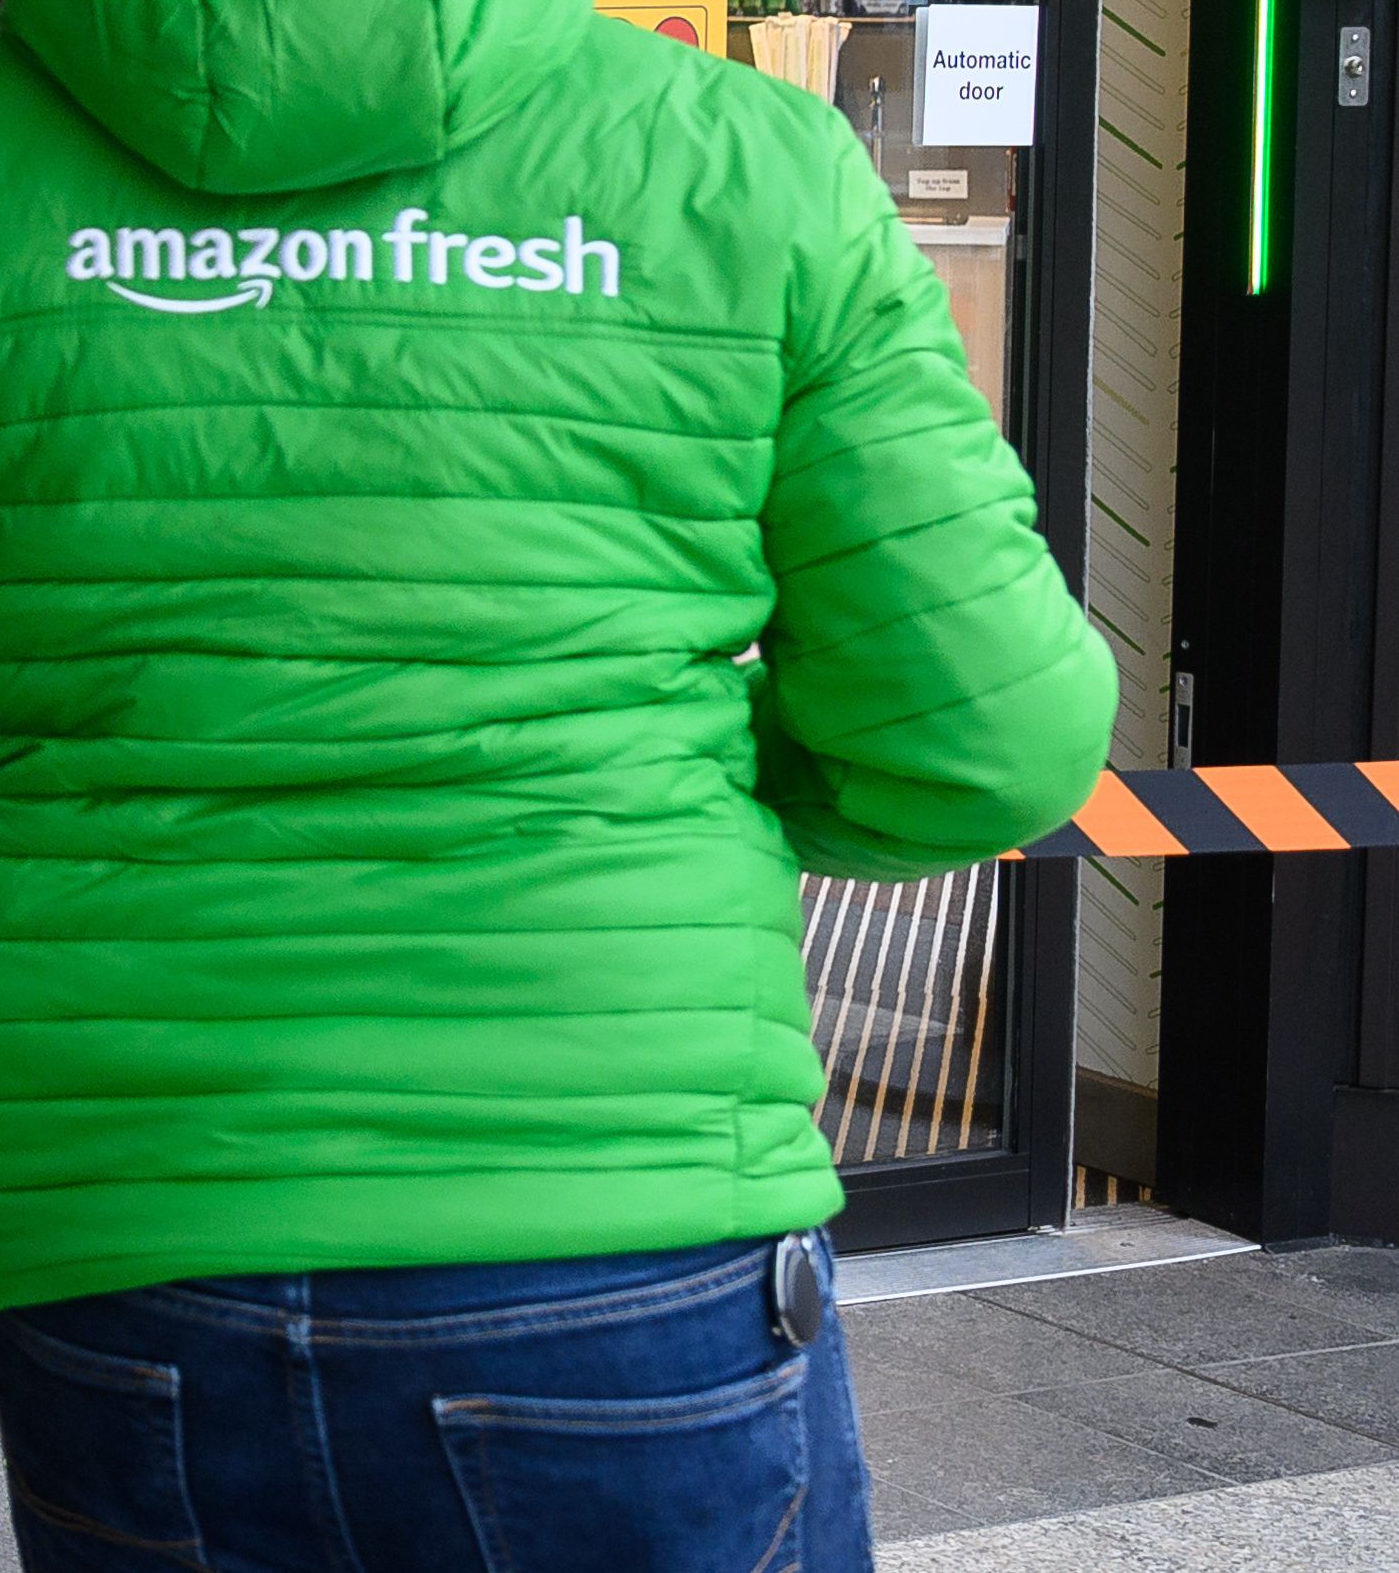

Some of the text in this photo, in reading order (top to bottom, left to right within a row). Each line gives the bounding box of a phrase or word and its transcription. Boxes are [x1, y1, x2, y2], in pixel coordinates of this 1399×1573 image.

[932, 50, 1032, 69] Automatic
[959, 81, 1004, 100] door
[66, 208, 620, 297] amazon fresh
